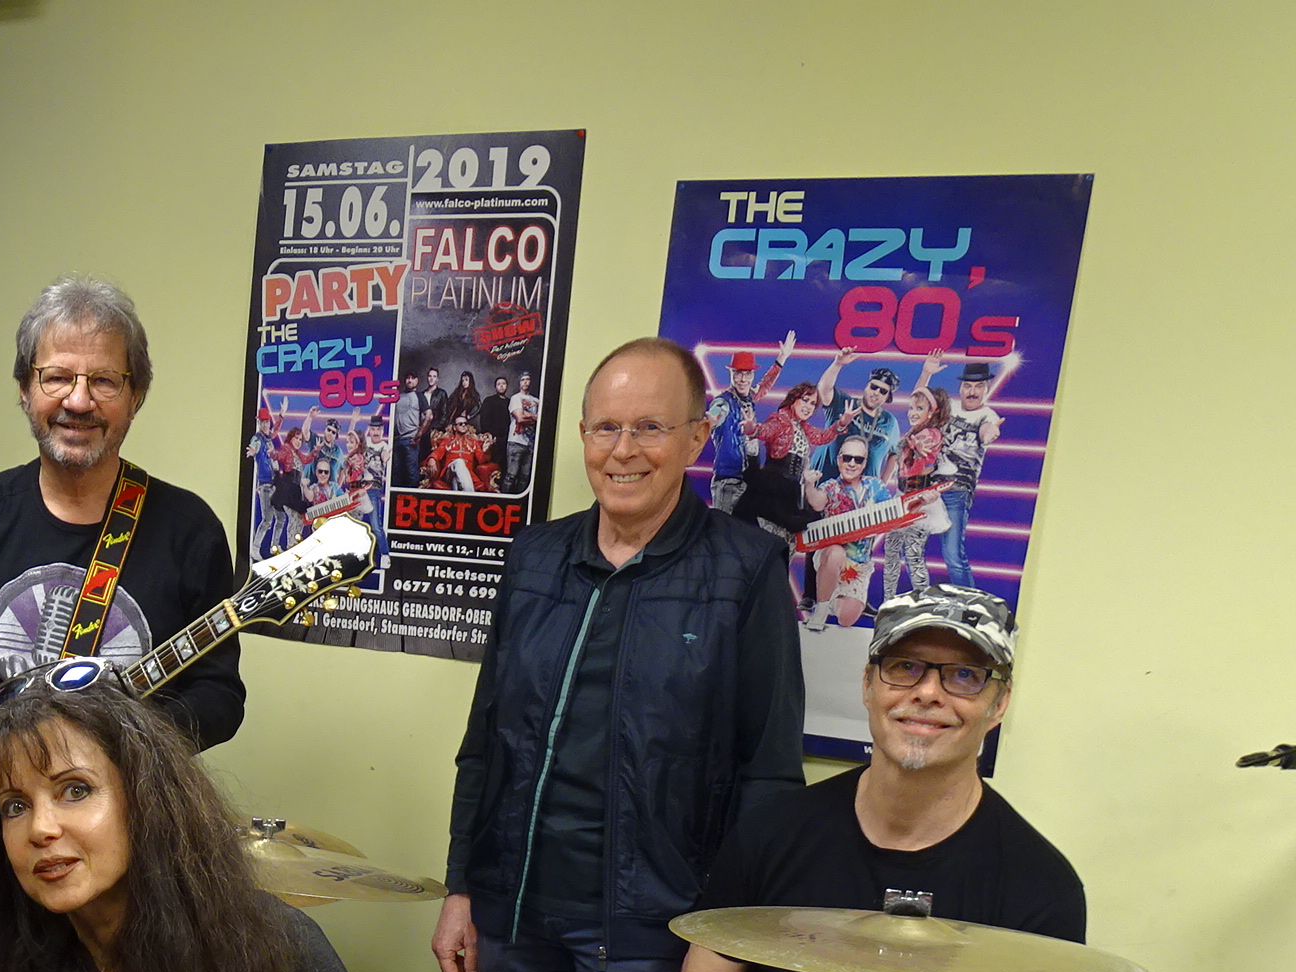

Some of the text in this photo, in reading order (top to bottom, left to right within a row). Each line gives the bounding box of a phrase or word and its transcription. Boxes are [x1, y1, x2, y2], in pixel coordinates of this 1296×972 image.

[287, 160, 404, 178] SAMSTAG
[413, 145, 551, 189] 2019
[282, 185, 401, 238] 15.06.
[415, 197, 549, 210] www.falco-platinum.com
[719, 190, 805, 223] THE
[320, 246, 334, 254] Uhr
[341, 246, 371, 255] Beginn:
[413, 226, 546, 272] FALCO
[708, 227, 972, 281] CRAZY
[263, 260, 410, 320] PARTY
[410, 276, 543, 310] PLATINUM
[257, 323, 298, 343] THE
[479, 319, 536, 344] SHOW
[256, 335, 373, 374] CRAZY
[395, 494, 522, 535] BEST OF
[390, 540, 424, 551] Karten:
[426, 543, 445, 553] VVK
[482, 548, 496, 557] AK
[393, 579, 497, 599] 0677 614 699
[426, 565, 502, 583] Ticketserv
[323, 612, 378, 635] Gerasdorf,
[381, 618, 468, 642] Stammersdorfer
[402, 602, 492, 625] GERASDORF-OBER
